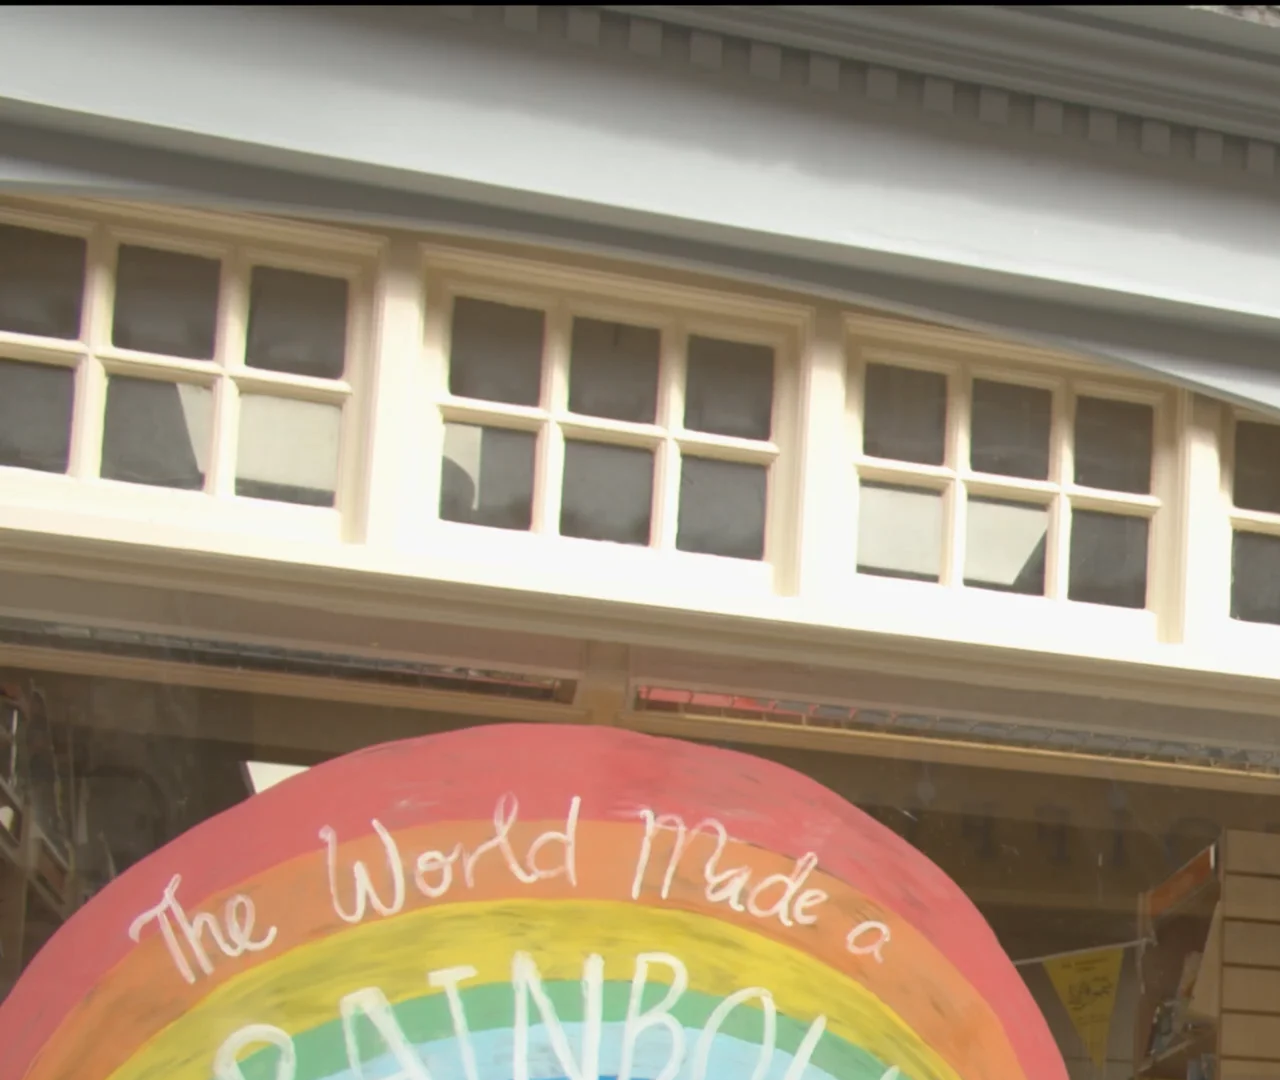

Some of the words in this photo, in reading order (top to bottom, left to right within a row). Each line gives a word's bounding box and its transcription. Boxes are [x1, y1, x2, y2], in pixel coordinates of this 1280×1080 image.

[129, 873, 277, 985] The
[319, 792, 581, 923] World
[632, 808, 826, 926] Made
[845, 919, 890, 963] a
